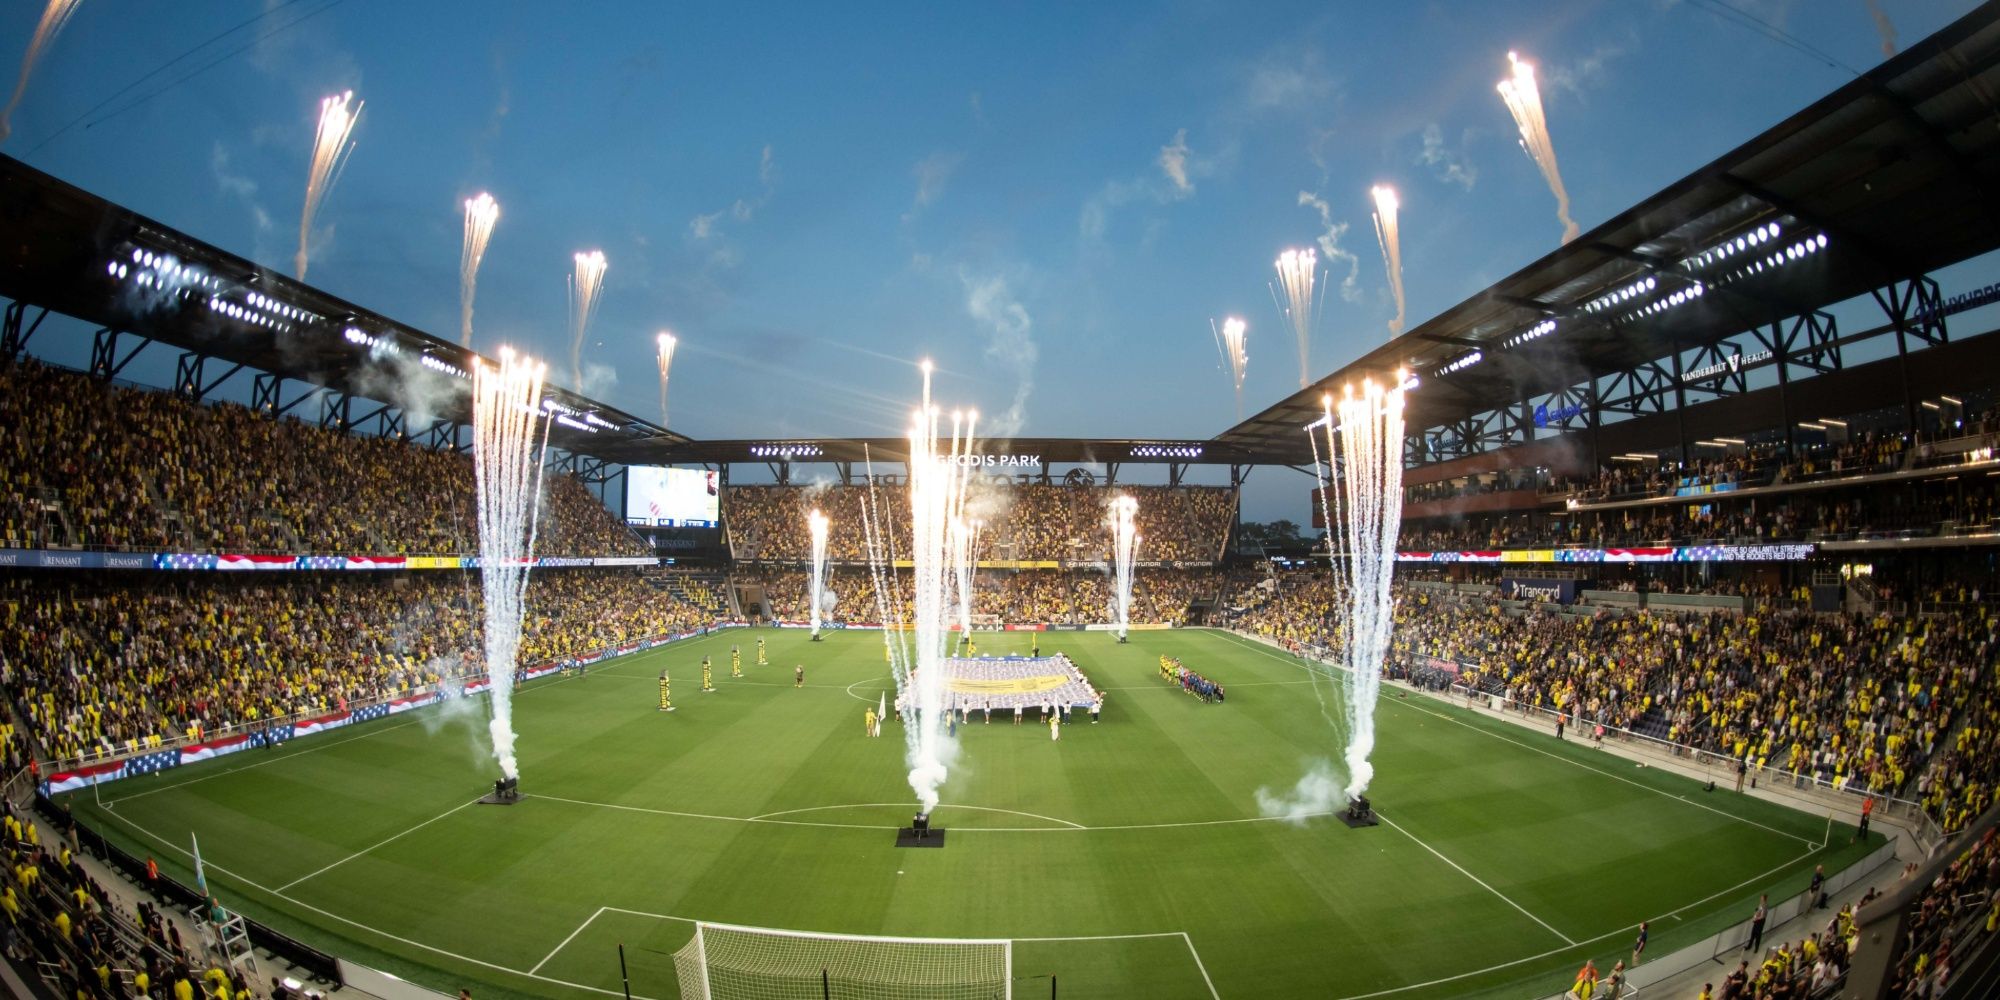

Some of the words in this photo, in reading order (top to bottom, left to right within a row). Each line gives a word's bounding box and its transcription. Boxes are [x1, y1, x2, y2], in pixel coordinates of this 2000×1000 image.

[1681, 362, 1727, 381] VANDERBILT
[1741, 350, 1773, 366] HEALTH
[935, 454, 995, 467] GEODIS
[1000, 454, 1040, 467] PARK
[1723, 546, 1739, 554] WERE
[1739, 546, 1748, 554] SO
[1780, 544, 1814, 552] STREAMING
[48, 556, 81, 566] RENASANT
[1774, 552, 1785, 560] RED
[1786, 552, 1806, 560] GLARE
[110, 558, 143, 567] RENASANT
[1519, 584, 1560, 600] Transcard
